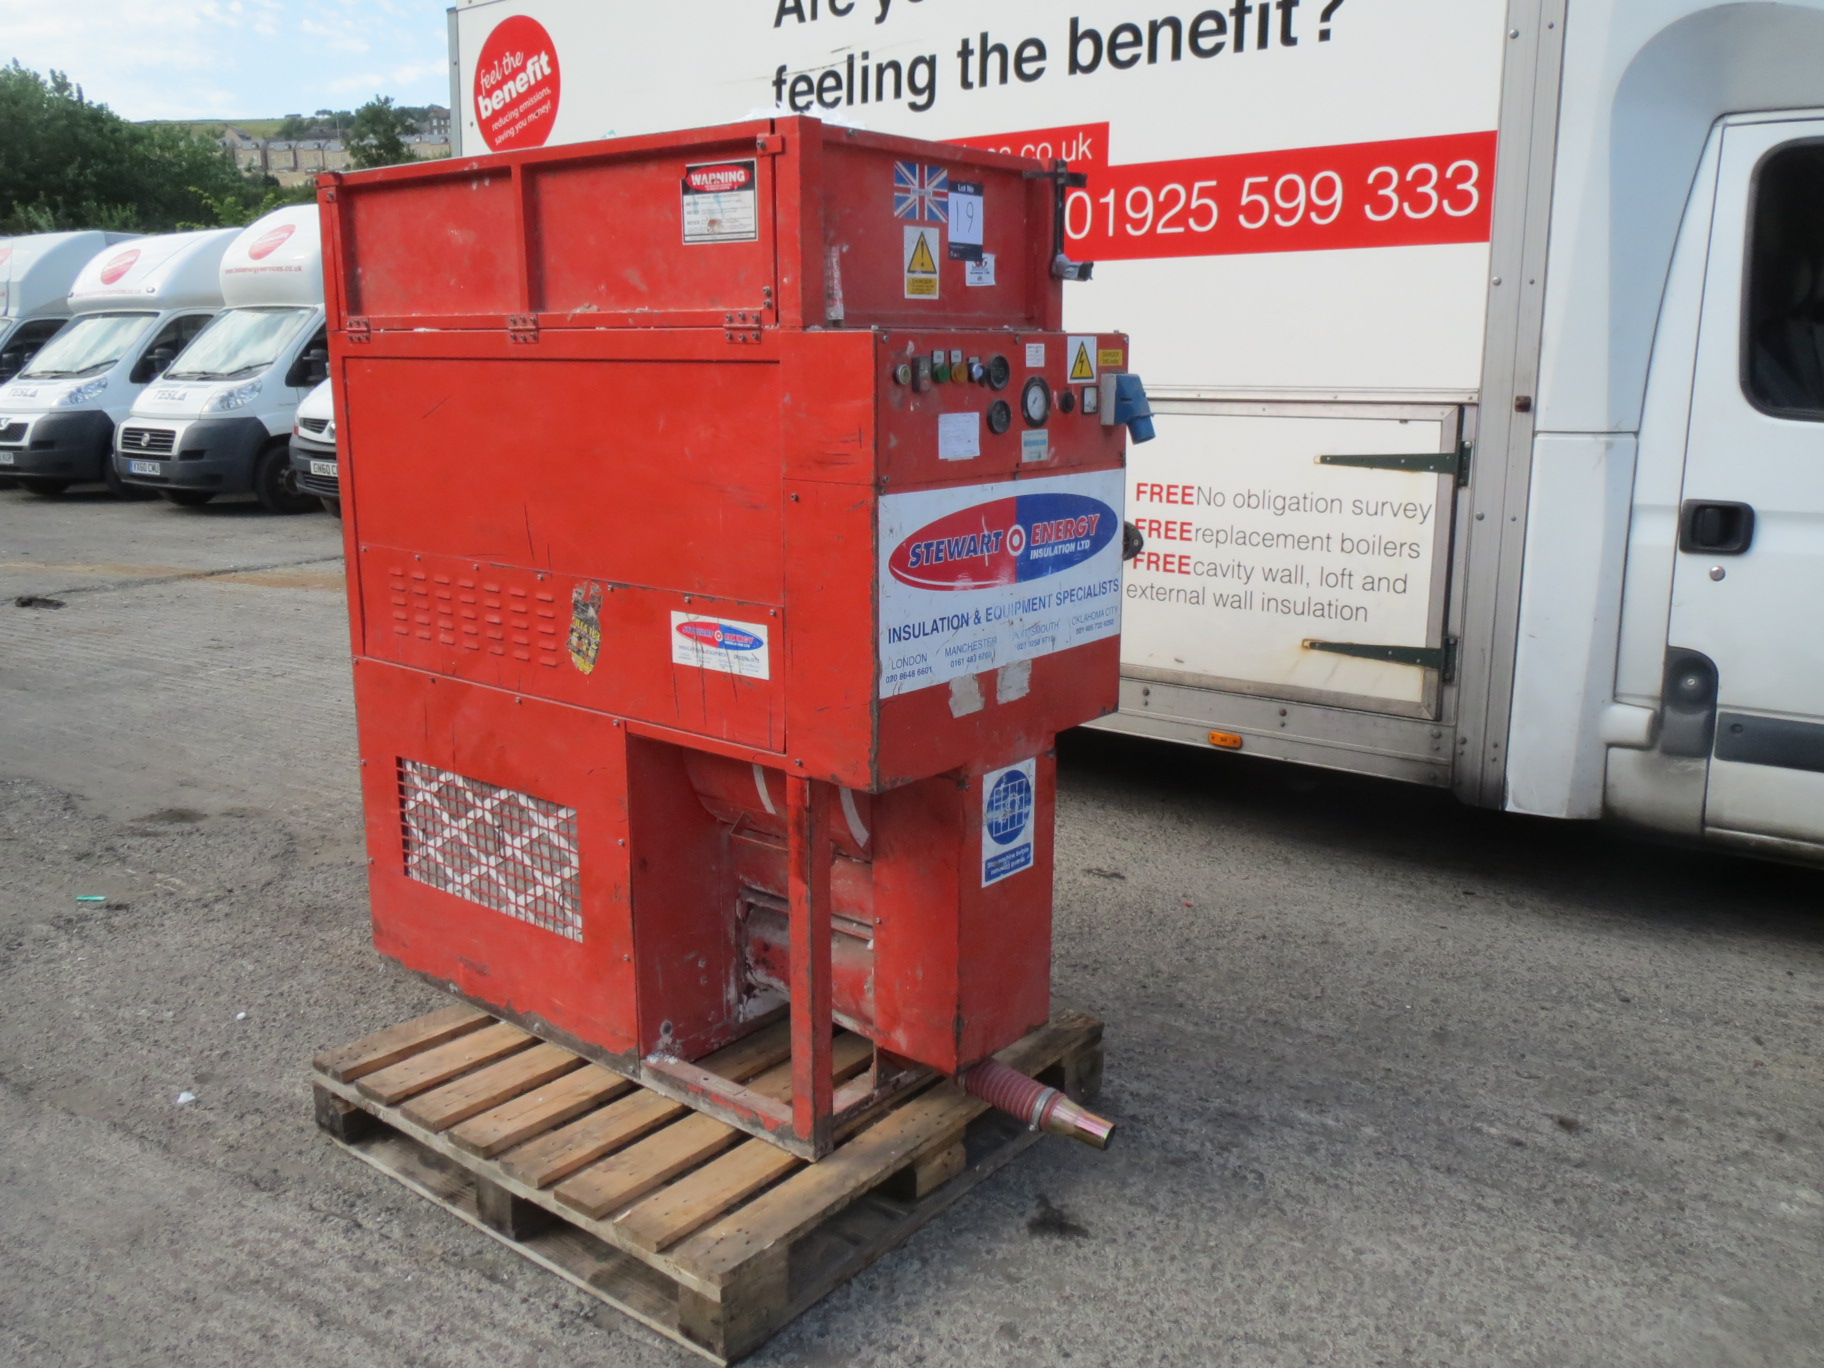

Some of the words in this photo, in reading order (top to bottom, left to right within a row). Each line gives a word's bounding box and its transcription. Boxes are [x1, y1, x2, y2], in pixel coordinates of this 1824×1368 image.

[477, 50, 552, 120] benefit
[480, 60, 502, 96] feel
[502, 51, 523, 76] the
[772, 51, 936, 112] feeling
[957, 31, 1047, 90] the
[491, 107, 519, 132] reducing
[494, 127, 515, 145] saving
[514, 117, 527, 134] you
[690, 170, 746, 186] WARNING
[957, 184, 967, 192] Lot
[1064, 180, 1218, 240] 01925
[1238, 169, 1343, 230] 599
[1364, 159, 1480, 222] 333
[955, 199, 974, 234] 19
[8, 388, 39, 398] TESLA
[154, 390, 188, 401] TESLA
[1136, 482, 1194, 505] FREE
[1196, 486, 1226, 507] No
[1233, 488, 1343, 516] obligation
[1352, 498, 1432, 525] survey
[907, 530, 1004, 568] STEWART
[1030, 513, 1100, 546] ENERGY
[1030, 543, 1075, 560] INSULATION
[1076, 540, 1091, 551] LTD
[1134, 518, 1193, 542] FREE
[1195, 525, 1332, 553] replacement
[1341, 532, 1421, 559] boilers
[1132, 551, 1191, 576] FREE
[1193, 559, 1254, 585] cavity
[1262, 564, 1311, 588] wall,
[1320, 566, 1354, 590] loft
[1361, 573, 1408, 594] and
[888, 611, 969, 644] INSULATION
[973, 609, 982, 625] &
[985, 595, 1053, 623] EQUIPMENT
[1055, 578, 1119, 606] SPECIALISTS
[1126, 581, 1206, 606] external
[1212, 590, 1253, 611] wall
[1261, 591, 1368, 622] insulation
[1071, 609, 1105, 626] OKLAHOMA
[891, 653, 928, 670] LONDON
[944, 636, 997, 658] MANCHESTER
[950, 657, 965, 668] 0161
